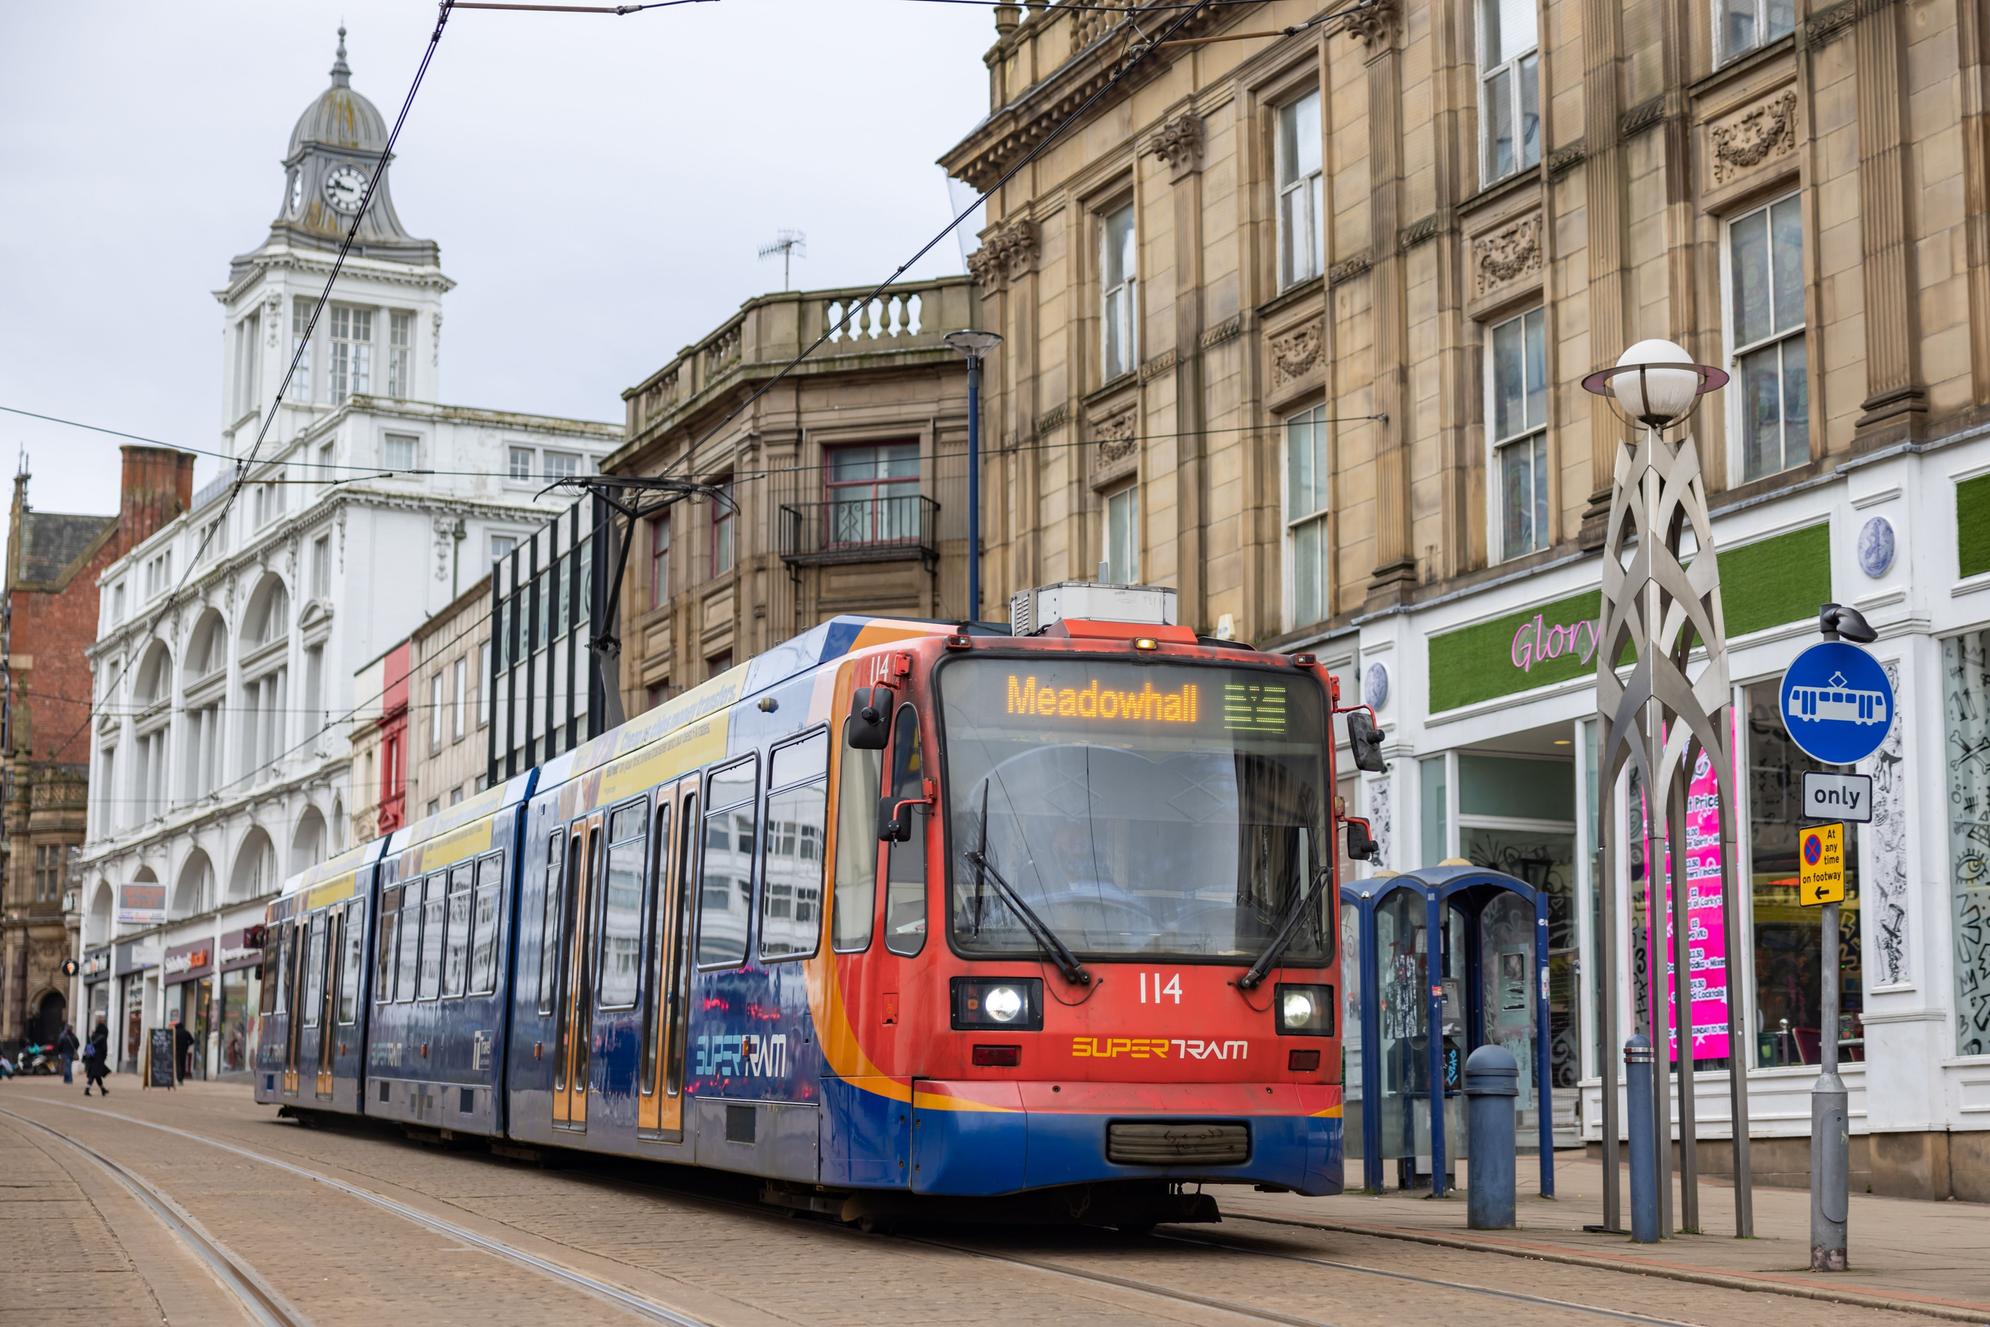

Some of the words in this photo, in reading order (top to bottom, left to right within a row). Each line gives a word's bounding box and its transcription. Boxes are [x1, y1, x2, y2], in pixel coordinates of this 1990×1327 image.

[1511, 613, 1600, 673] Glory
[870, 653, 890, 686] 114
[1007, 675, 1197, 722] Meadowhall
[1814, 786, 1860, 809] only
[1827, 829, 1836, 839] At
[1825, 843, 1838, 853] any
[1824, 855, 1839, 865] time
[1802, 875, 1811, 884] on
[1813, 871, 1841, 883] footway
[1139, 972, 1183, 1005] 114
[1072, 1037, 1248, 1060] SUPERTRAM
